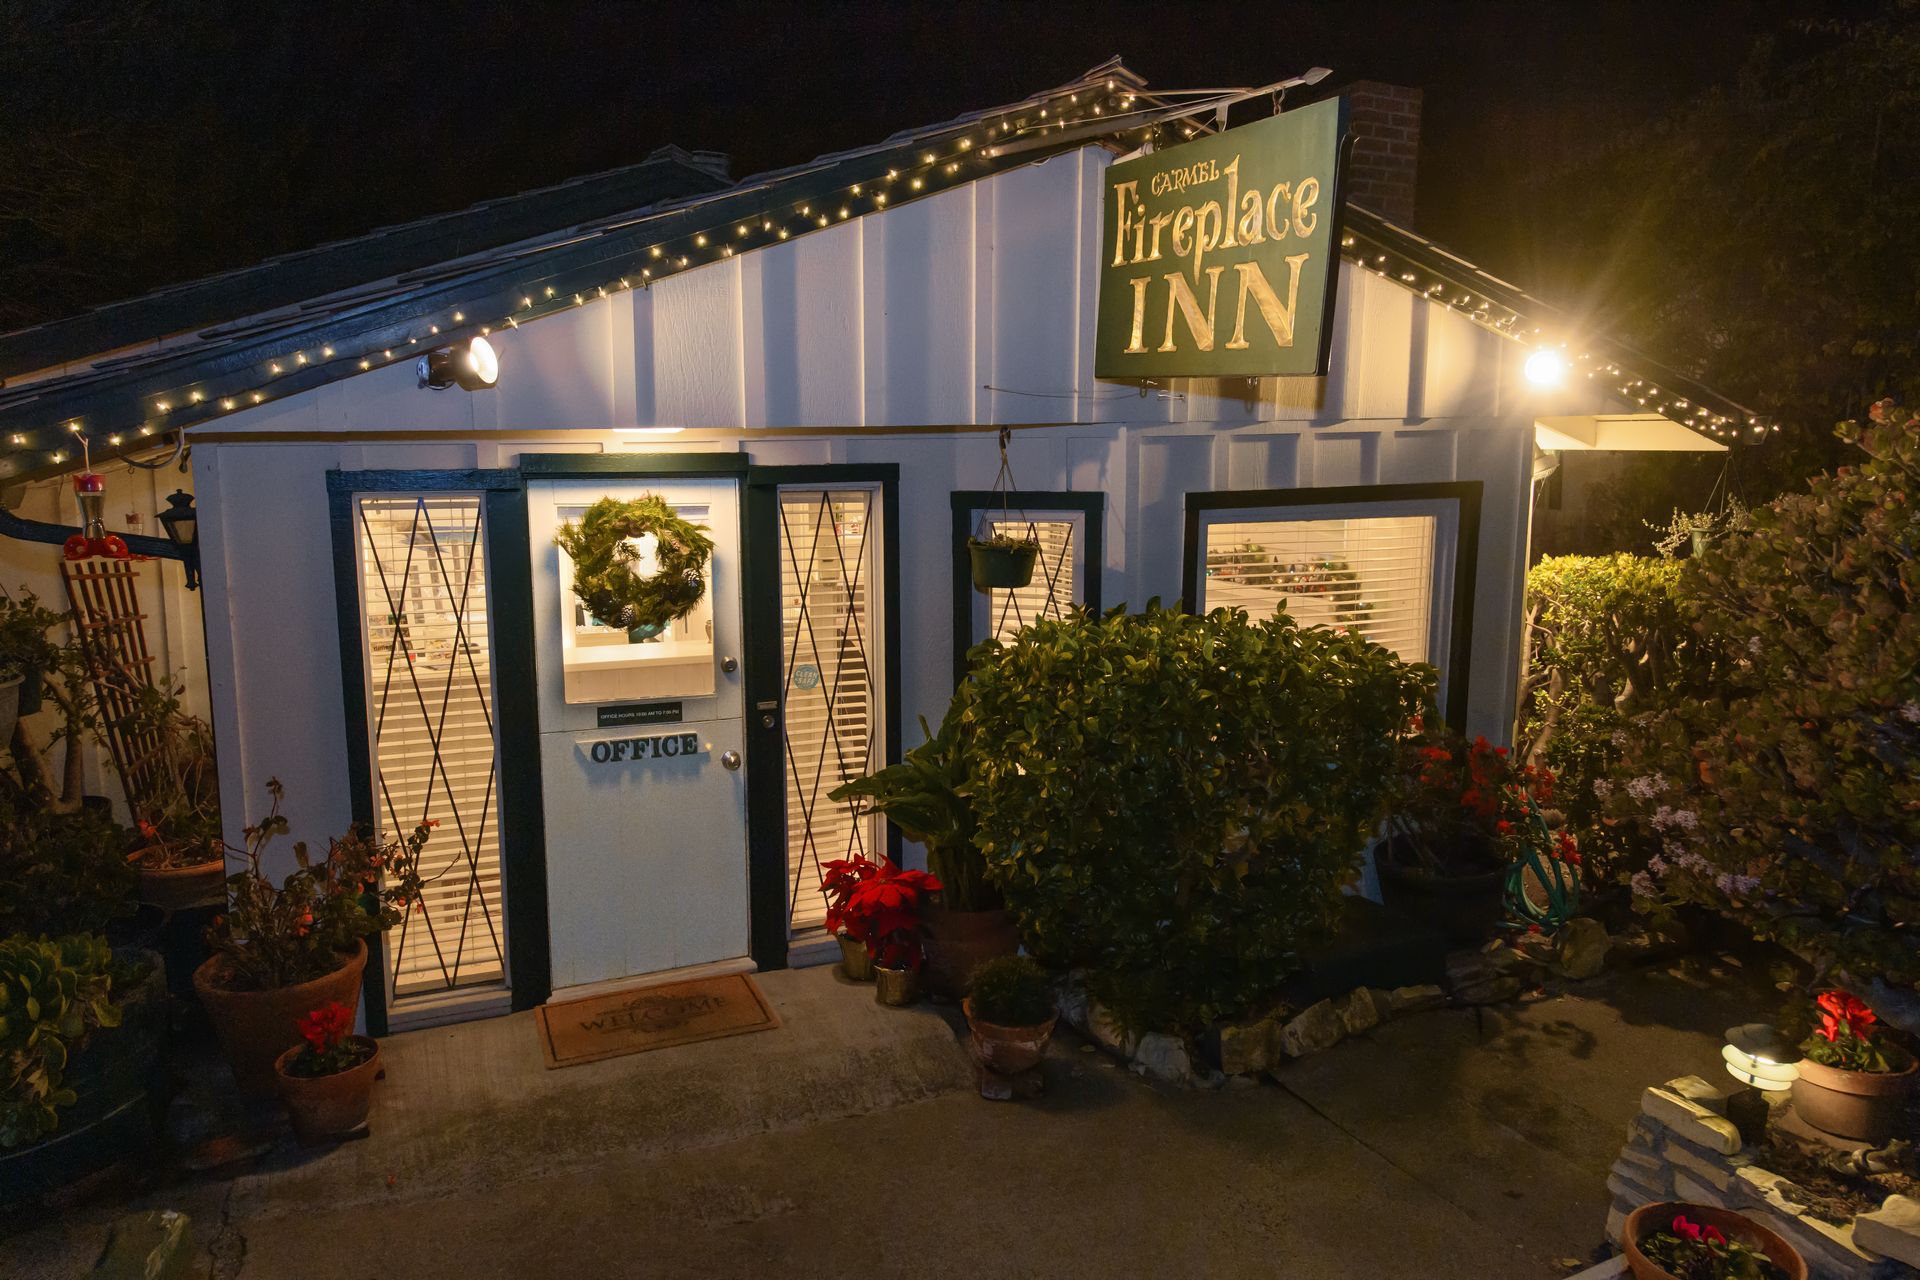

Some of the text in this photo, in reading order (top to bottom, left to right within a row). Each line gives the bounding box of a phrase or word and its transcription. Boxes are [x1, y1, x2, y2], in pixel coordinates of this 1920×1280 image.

[1152, 159, 1219, 197] CARMEL
[1111, 154, 1320, 285] Fireplace
[1124, 253, 1309, 354] INN
[591, 733, 698, 763] OFFICE
[580, 996, 726, 1031] WELCOME
